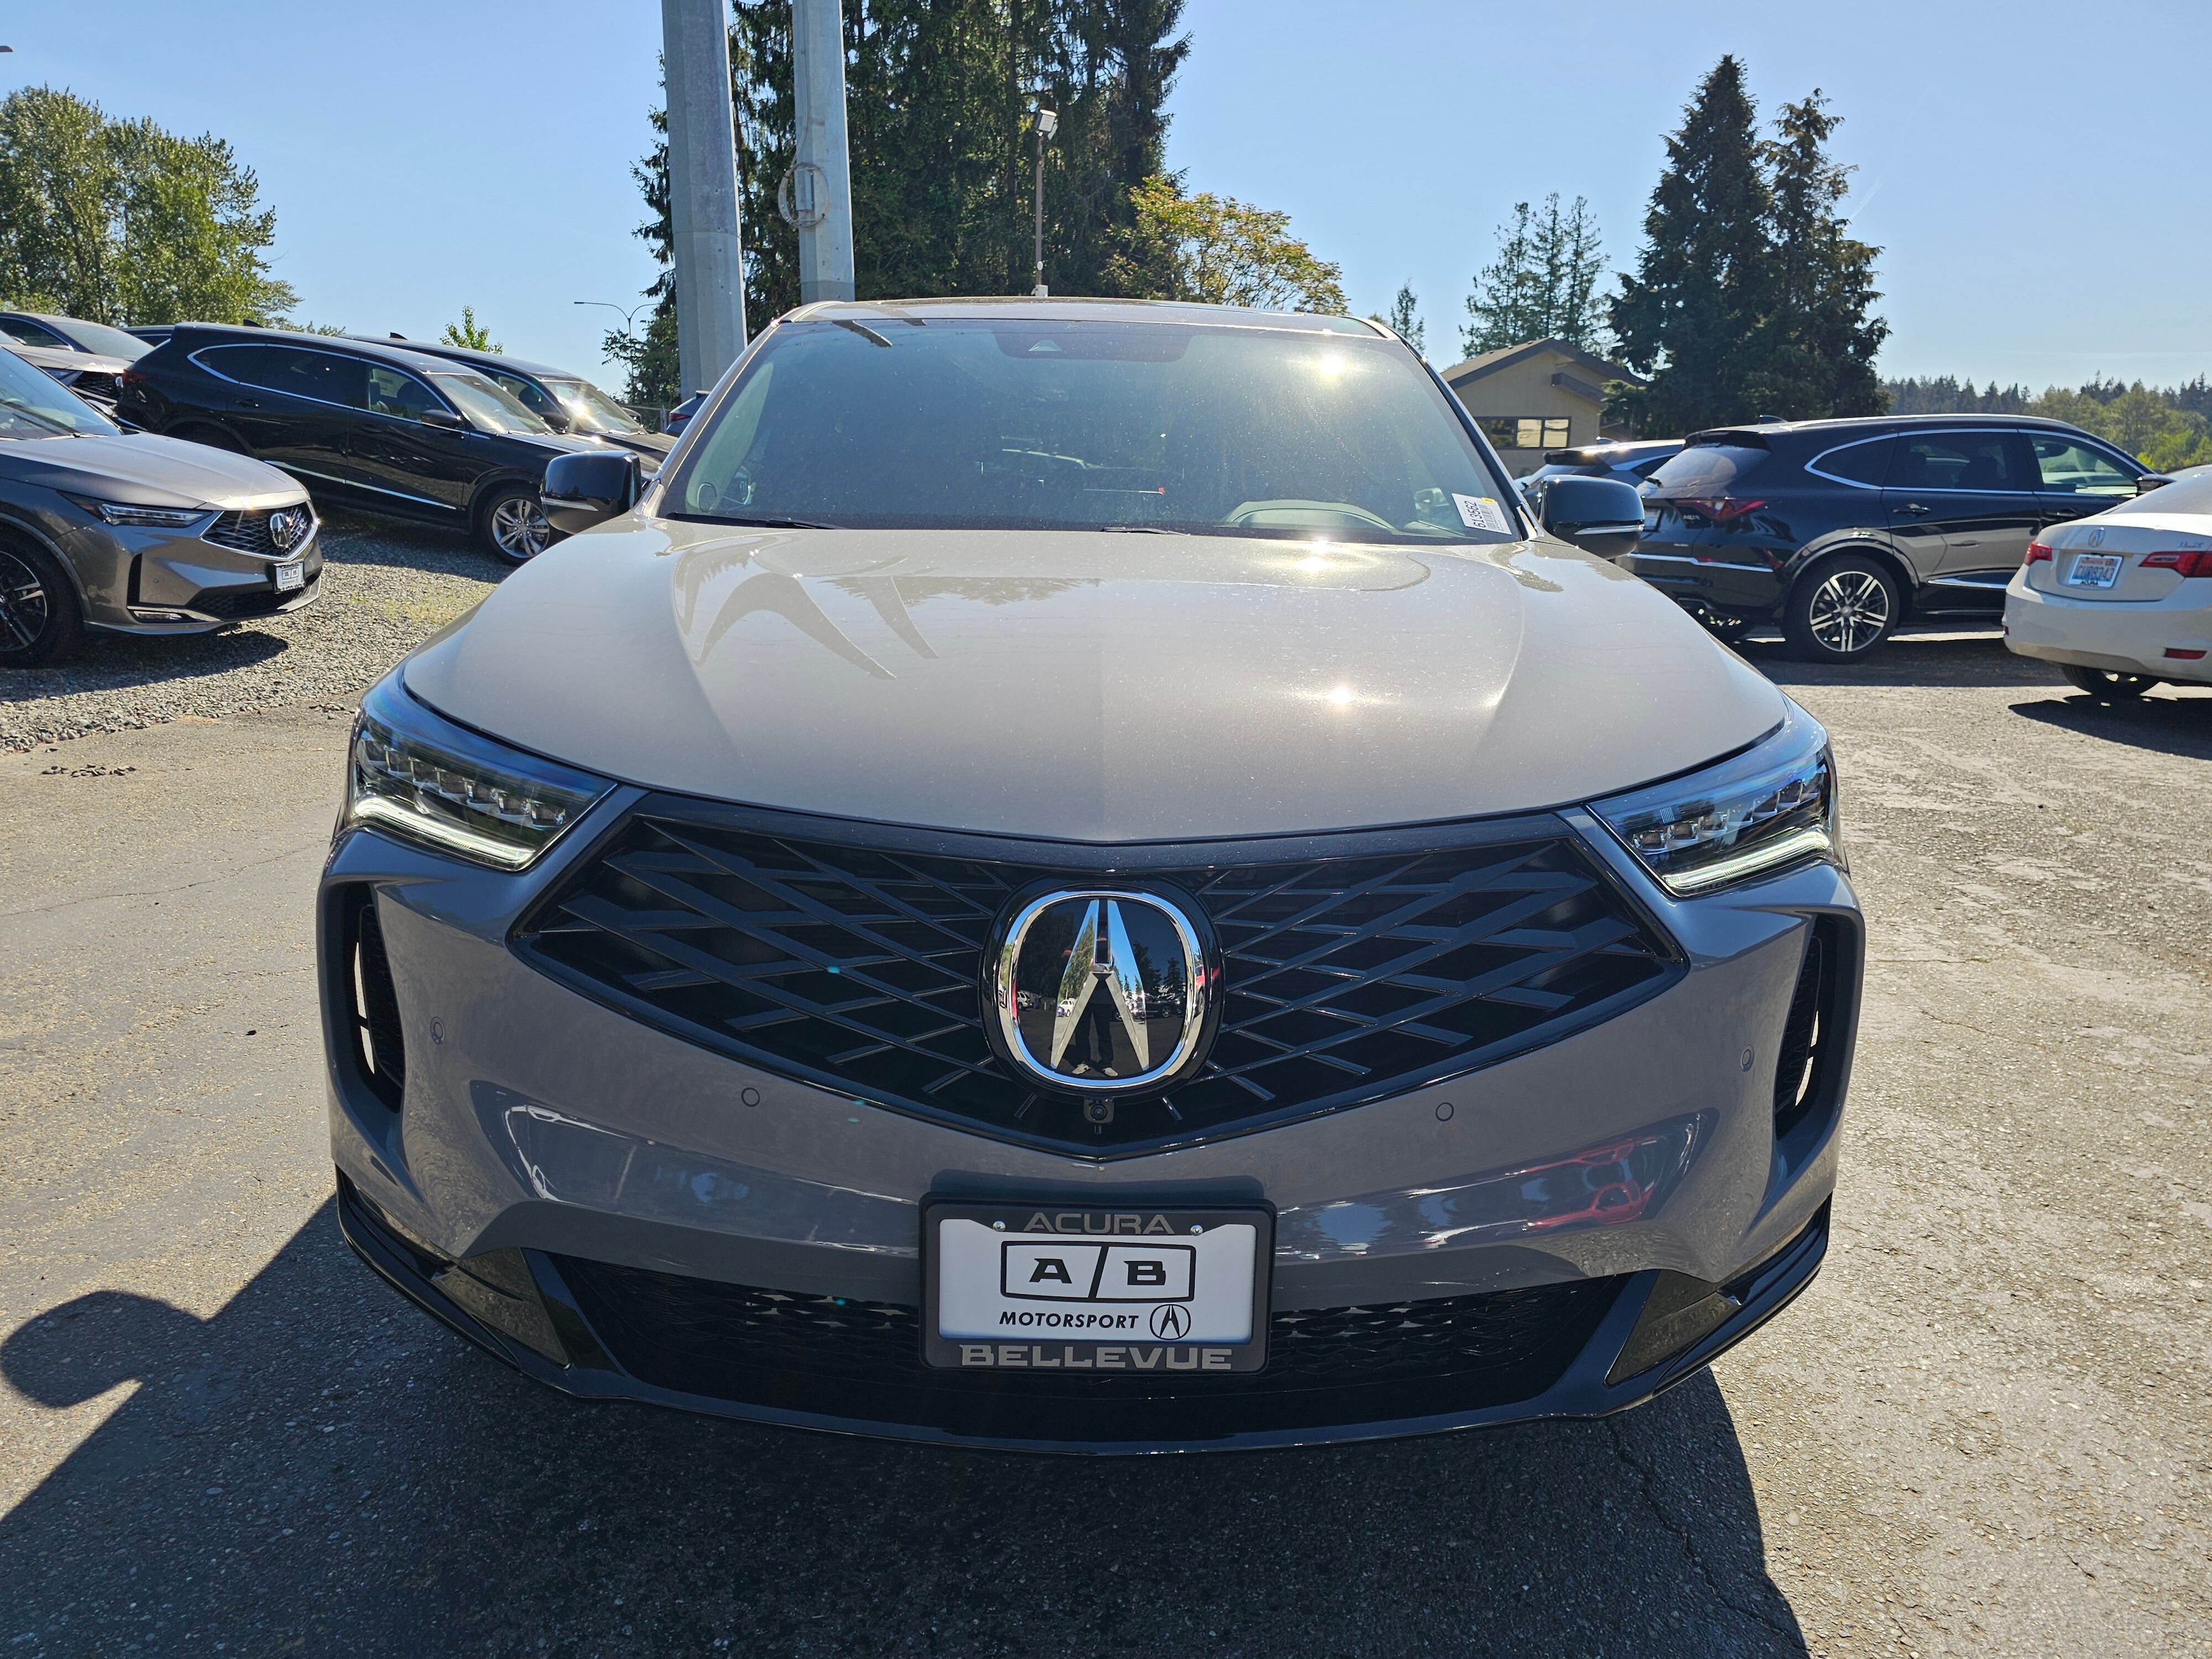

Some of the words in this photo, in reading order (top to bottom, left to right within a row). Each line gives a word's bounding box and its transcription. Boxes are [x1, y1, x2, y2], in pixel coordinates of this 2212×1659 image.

[1464, 500, 1486, 528] 613562
[1023, 1212, 1175, 1235] ACURA
[1029, 1258, 1072, 1284] A
[1123, 1260, 1166, 1286] B
[999, 1311, 1139, 1329] MOTORSPORT
[958, 1344, 1233, 1370] BELLEVUE
